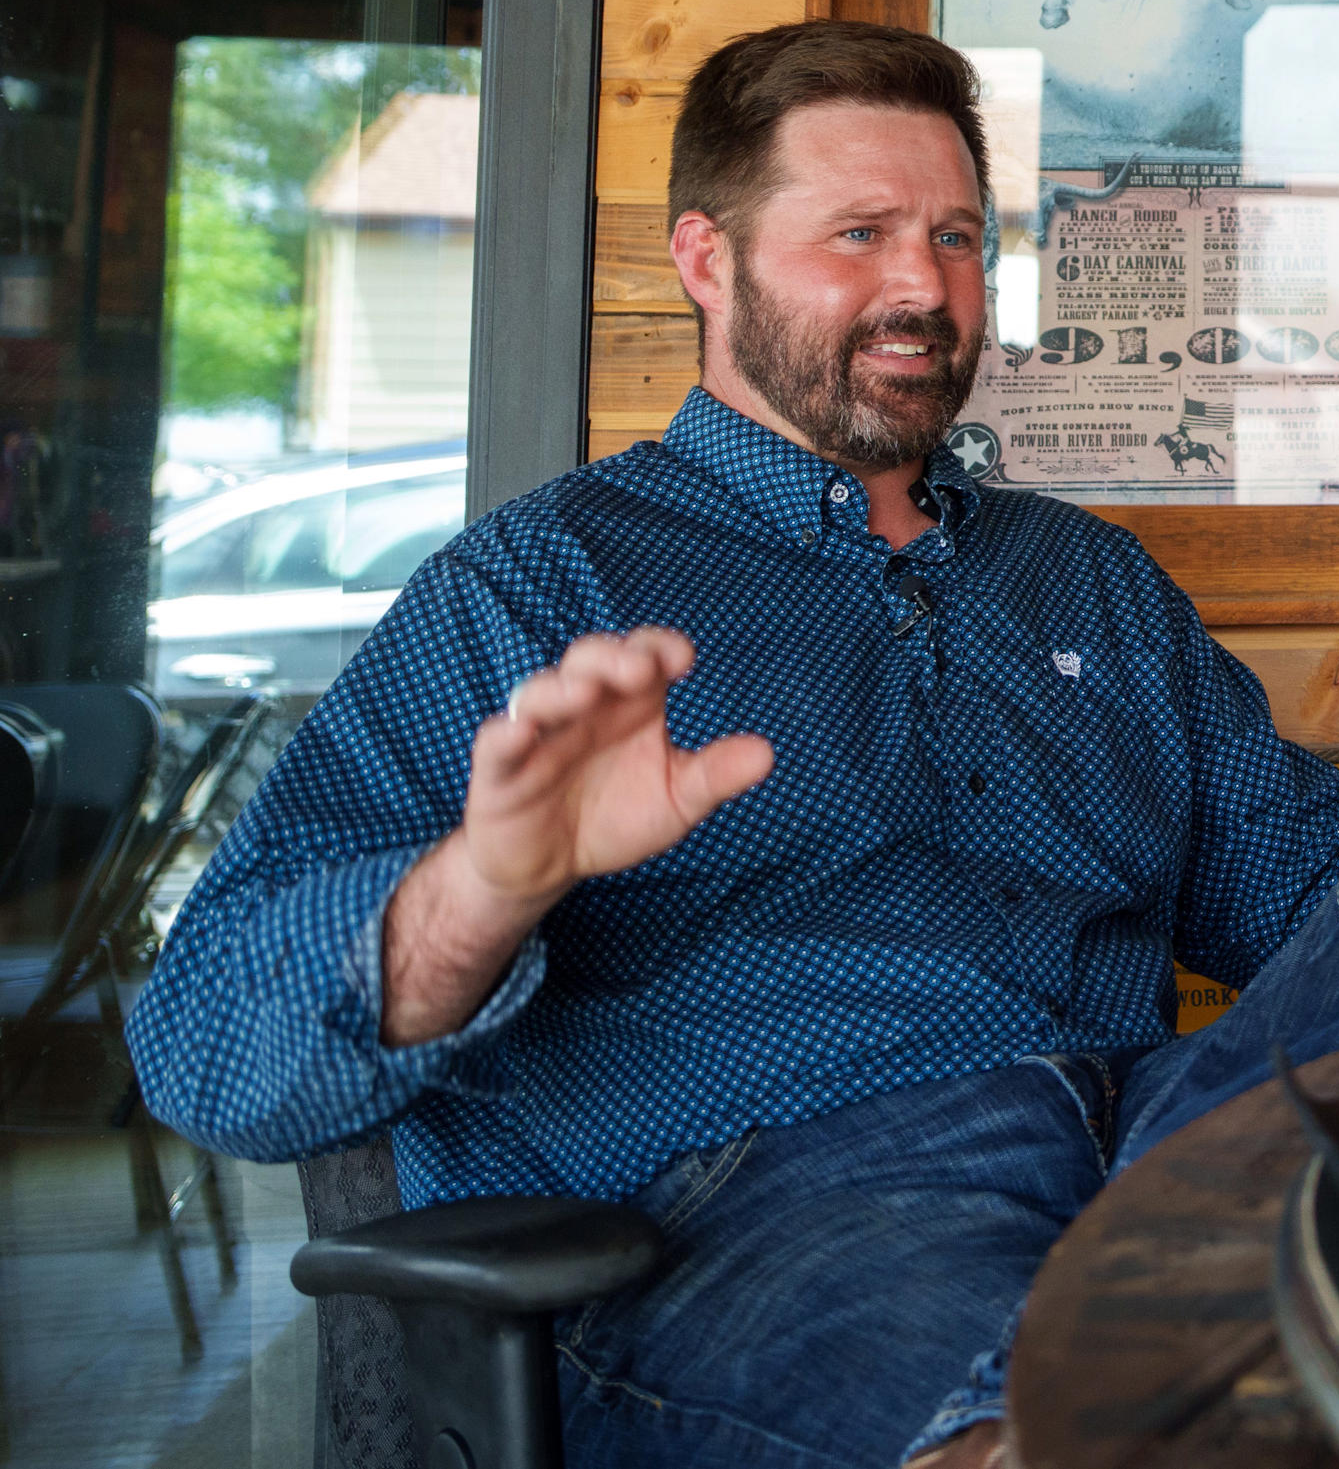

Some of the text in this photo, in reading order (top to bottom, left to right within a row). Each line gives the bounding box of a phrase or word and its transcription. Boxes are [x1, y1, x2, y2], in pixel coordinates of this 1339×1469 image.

[1070, 210, 1178, 222] RANCH RODEO
[1056, 255, 1080, 282] 6
[1083, 255, 1111, 270] DAY
[1116, 255, 1187, 270] CARNIVAL
[1057, 311, 1139, 321] LARGEST PARADE
[1203, 307, 1229, 316] HUGE
[1000, 403, 1174, 417] MOST EXCITING SHOW SINCE
[1025, 422, 1132, 431] STOCK CONTRACTOR
[1010, 433, 1148, 448] POWDER RIVER RODEO
[1177, 987, 1239, 1007] WORK
